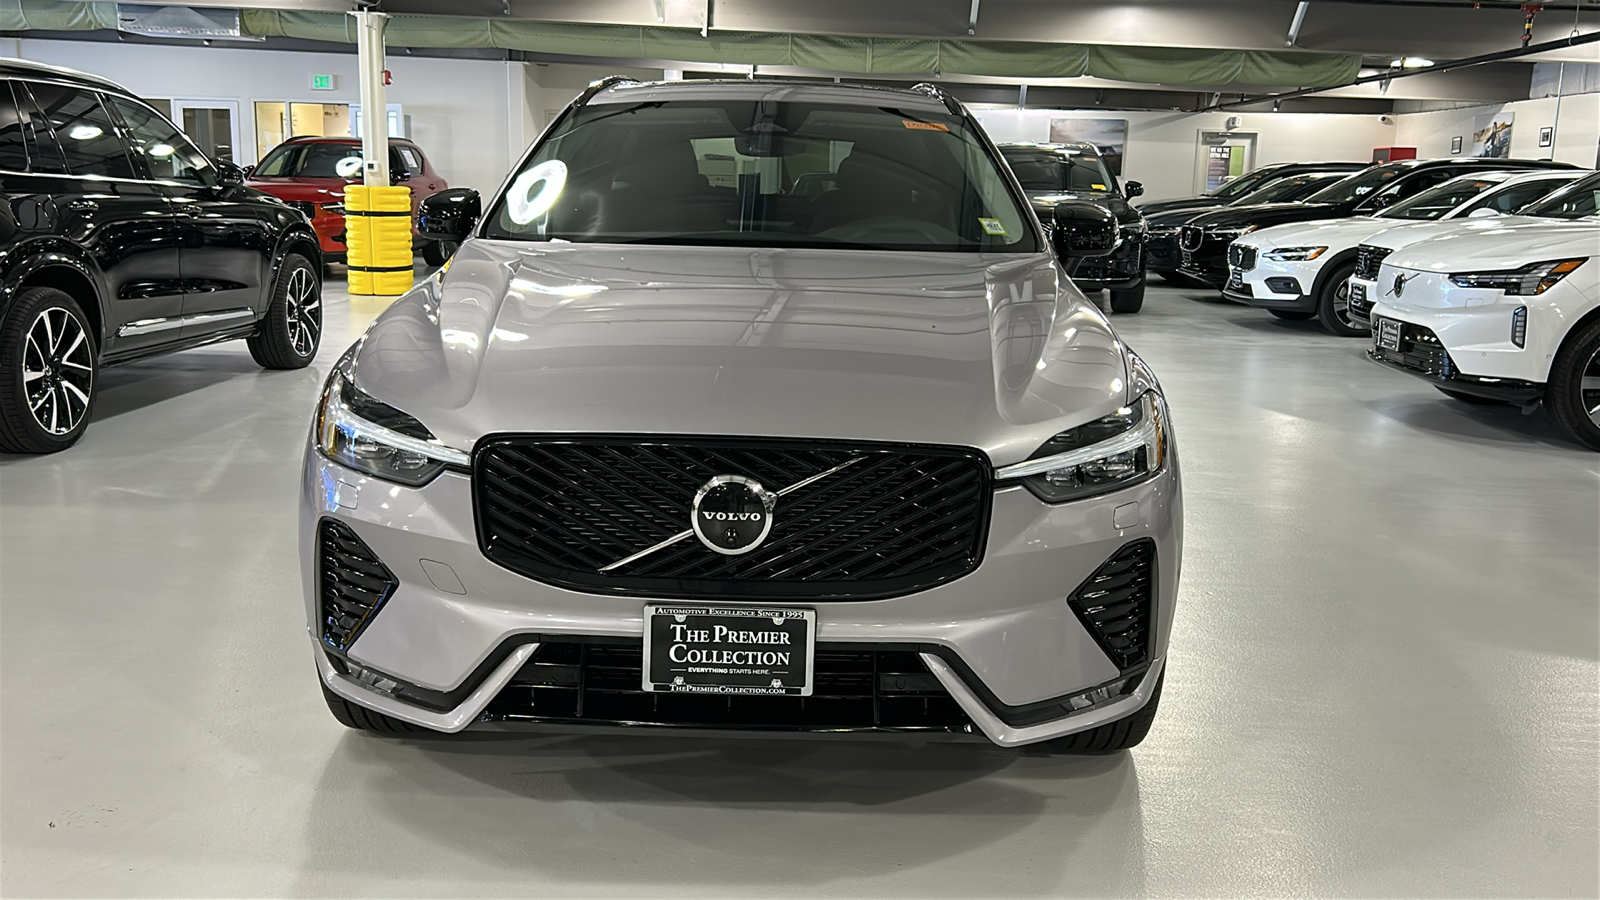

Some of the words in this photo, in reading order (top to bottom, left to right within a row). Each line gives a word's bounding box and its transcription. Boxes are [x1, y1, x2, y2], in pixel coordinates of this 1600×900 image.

[314, 75, 330, 89] EXIT
[702, 511, 761, 521] VOLVO
[657, 607, 707, 615] AUTOMOTIVE
[709, 607, 756, 617] EXCELLENCE
[757, 609, 780, 617] SINCE
[782, 611, 803, 619] 1995
[670, 624, 710, 643] THE
[713, 625, 791, 645] PREMIER
[669, 643, 791, 666] COLLECTION
